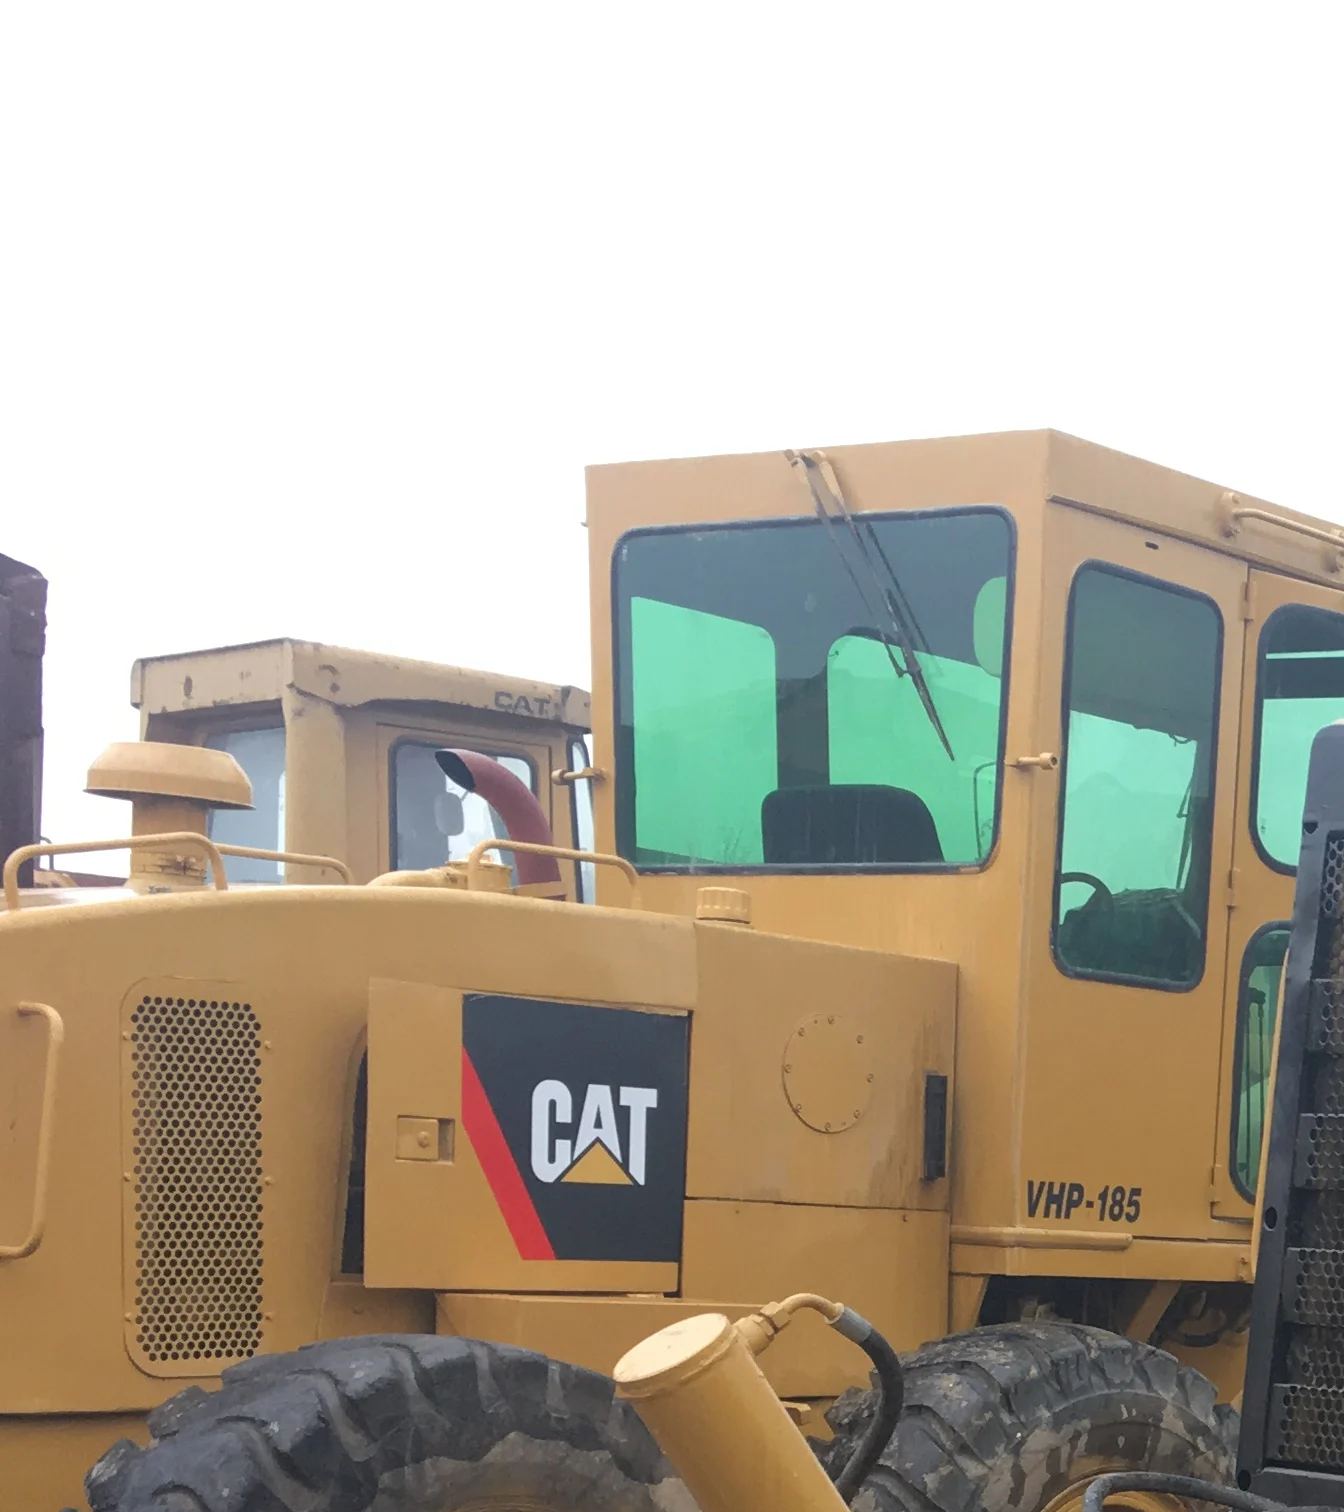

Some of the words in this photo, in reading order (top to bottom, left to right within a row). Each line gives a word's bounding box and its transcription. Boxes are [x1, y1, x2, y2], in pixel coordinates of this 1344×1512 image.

[494, 691, 551, 715] CAT
[530, 1079, 658, 1186] CAT
[1027, 1180, 1143, 1223] VHP-185
